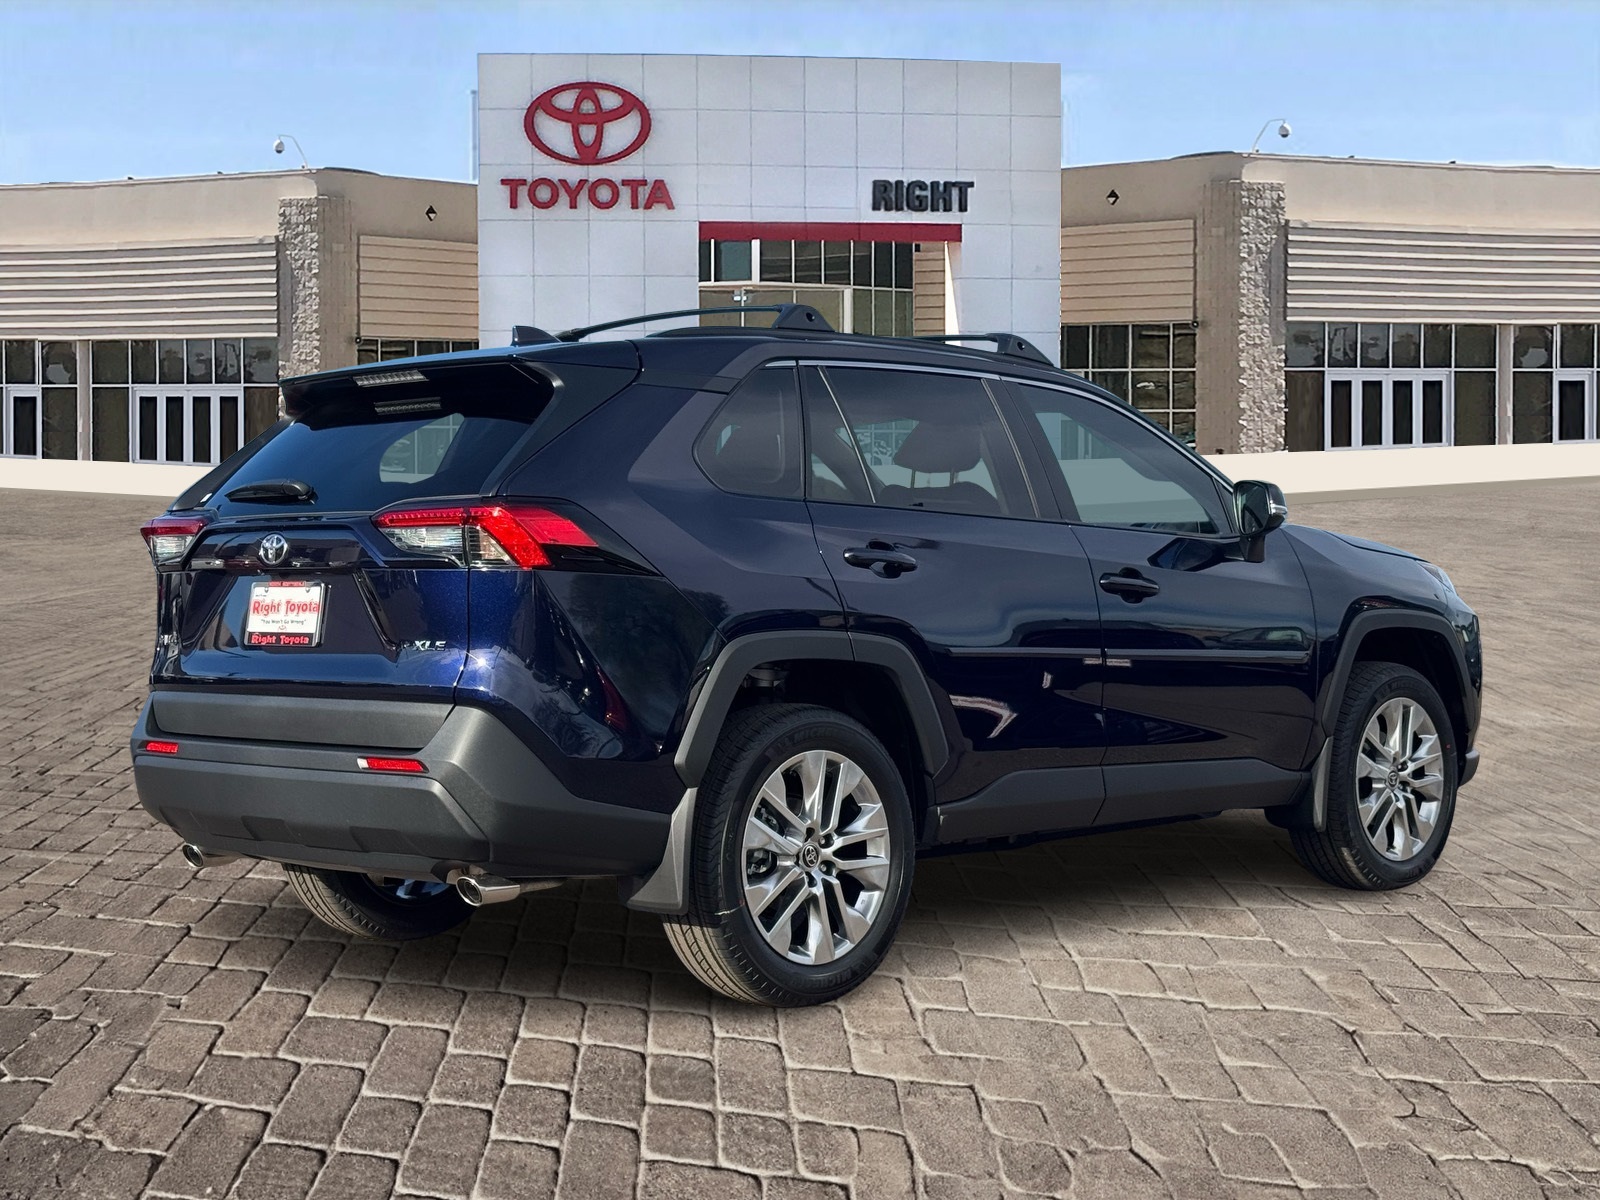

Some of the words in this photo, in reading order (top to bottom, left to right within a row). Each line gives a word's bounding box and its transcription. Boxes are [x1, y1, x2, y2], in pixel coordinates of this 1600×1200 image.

[500, 178, 675, 210] TOYOTA
[871, 179, 975, 213] RIGHT
[253, 600, 281, 616] Right
[285, 600, 319, 615] Toyota
[251, 634, 276, 645] Right
[280, 635, 309, 645] Toyota
[412, 640, 446, 651] XLE
